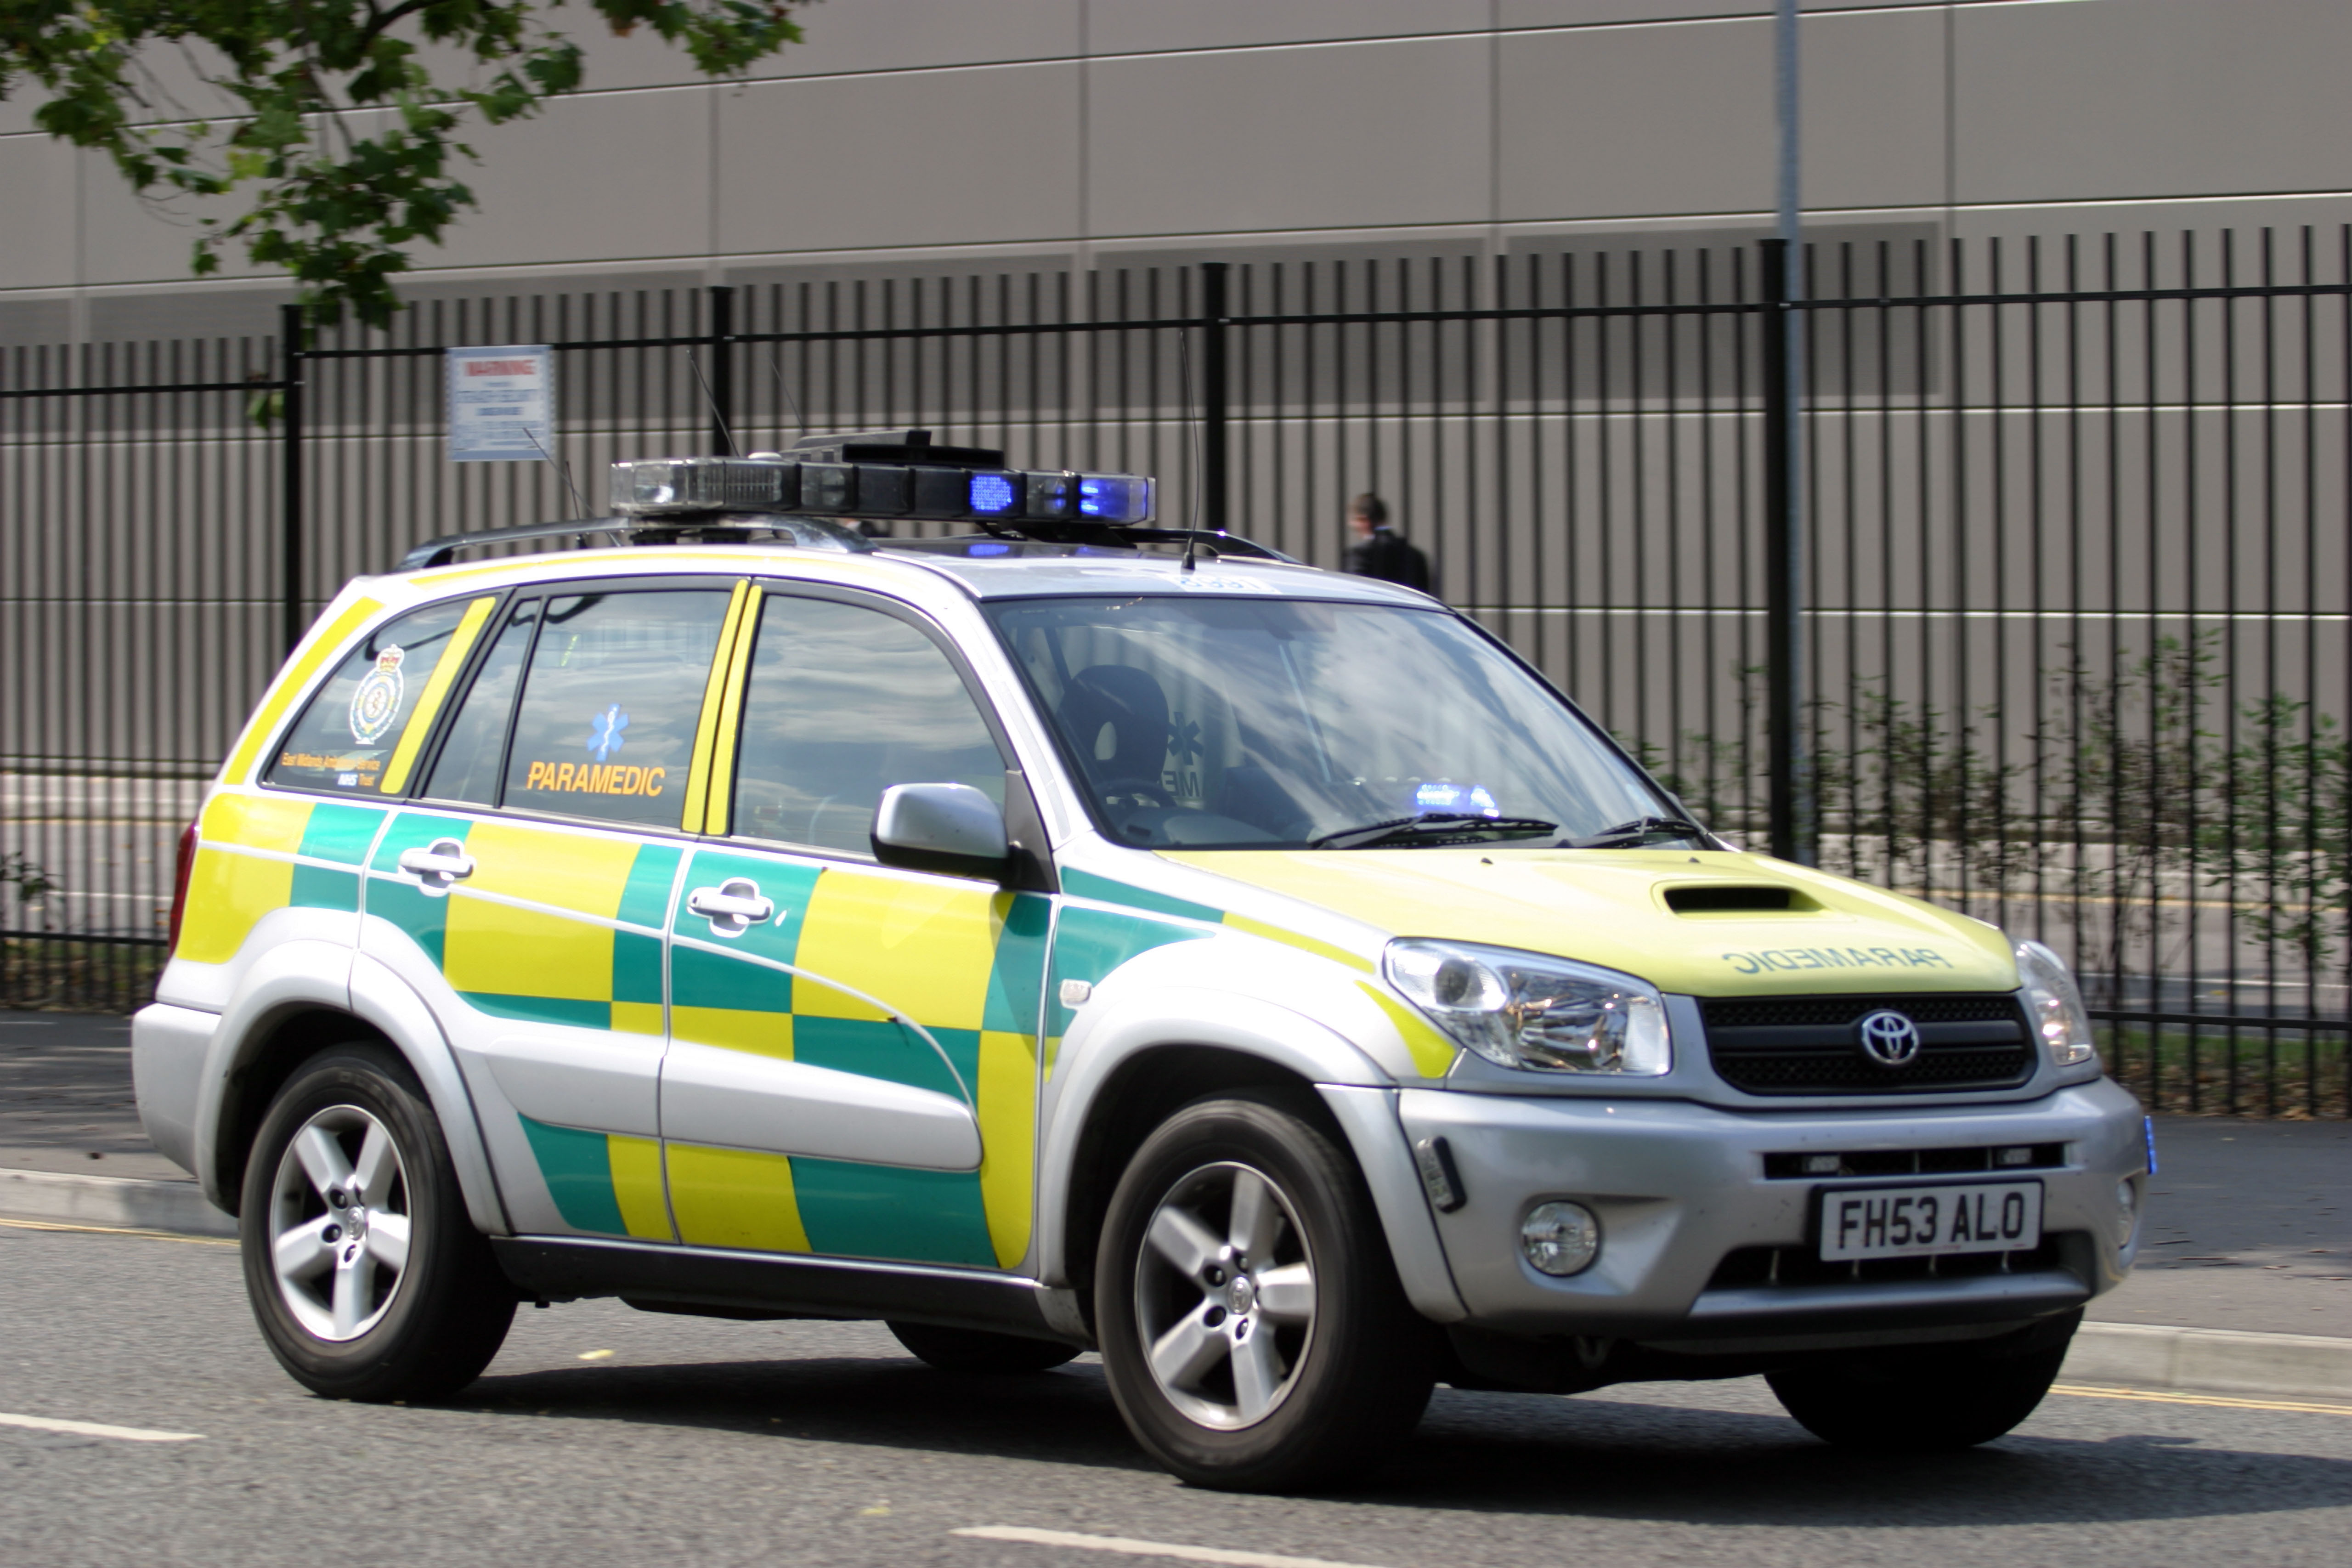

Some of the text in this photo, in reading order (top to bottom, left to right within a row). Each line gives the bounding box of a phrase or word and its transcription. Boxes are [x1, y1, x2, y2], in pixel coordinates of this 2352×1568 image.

[526, 761, 666, 797] PARAMEDIC
[1838, 1192, 2025, 1250] FH53 ALO
